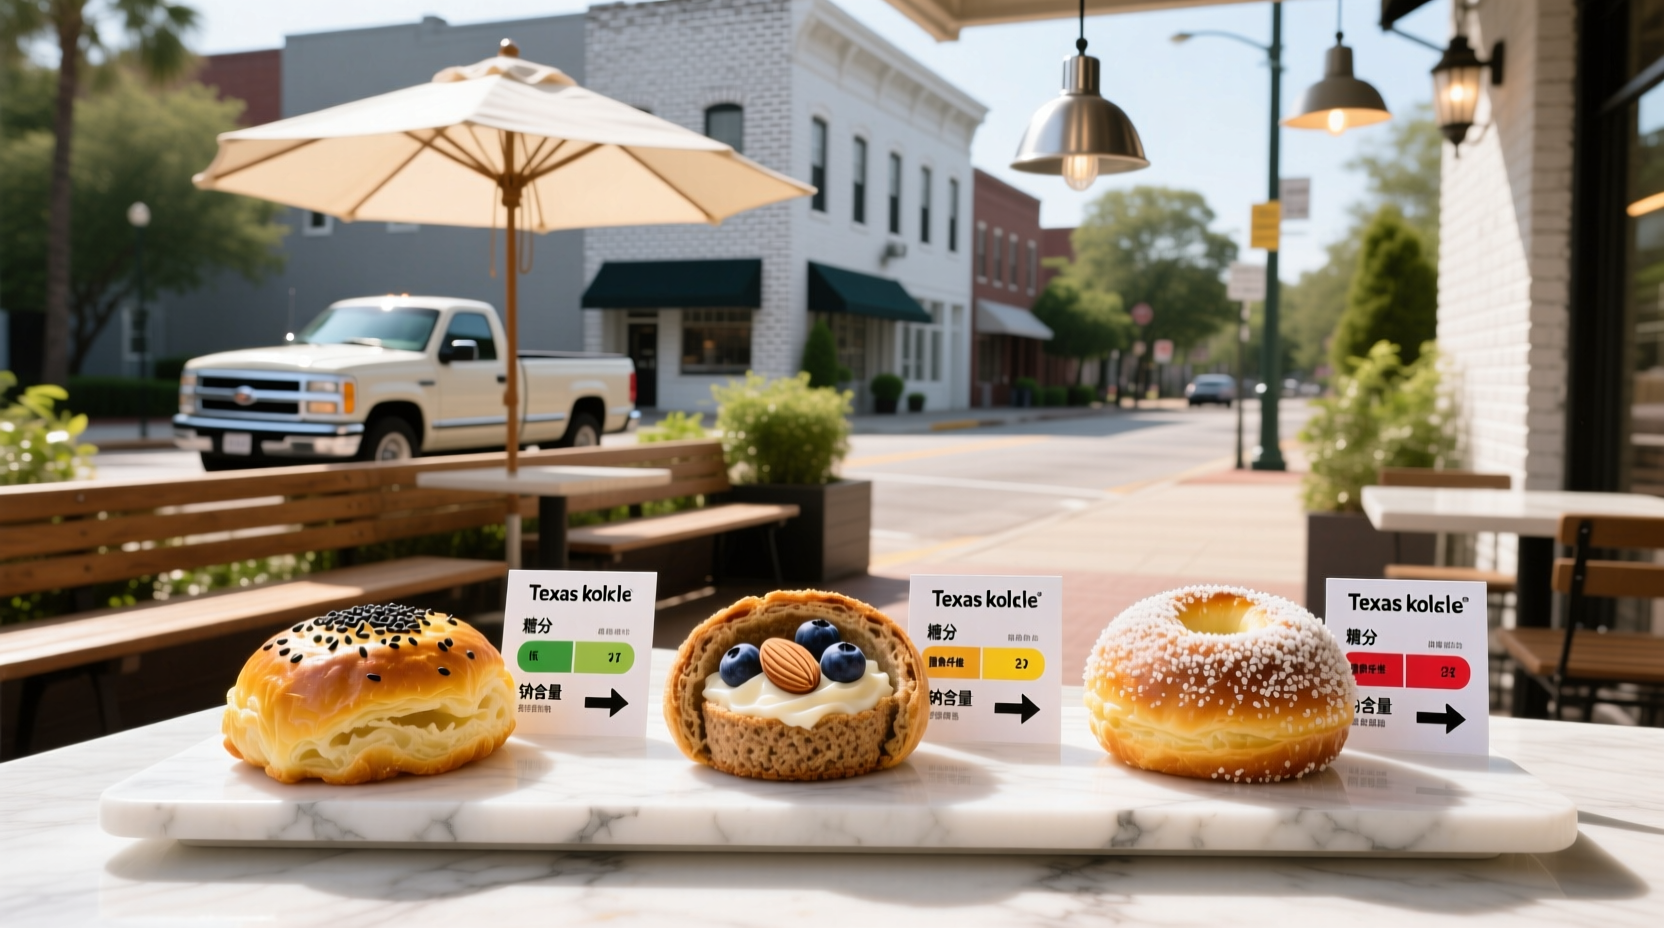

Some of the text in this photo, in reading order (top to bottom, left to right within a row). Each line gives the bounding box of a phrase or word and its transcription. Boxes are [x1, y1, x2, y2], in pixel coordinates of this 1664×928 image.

[529, 583, 578, 602] Texas
[931, 589, 982, 608] Texas
[1347, 592, 1402, 612] Texas
